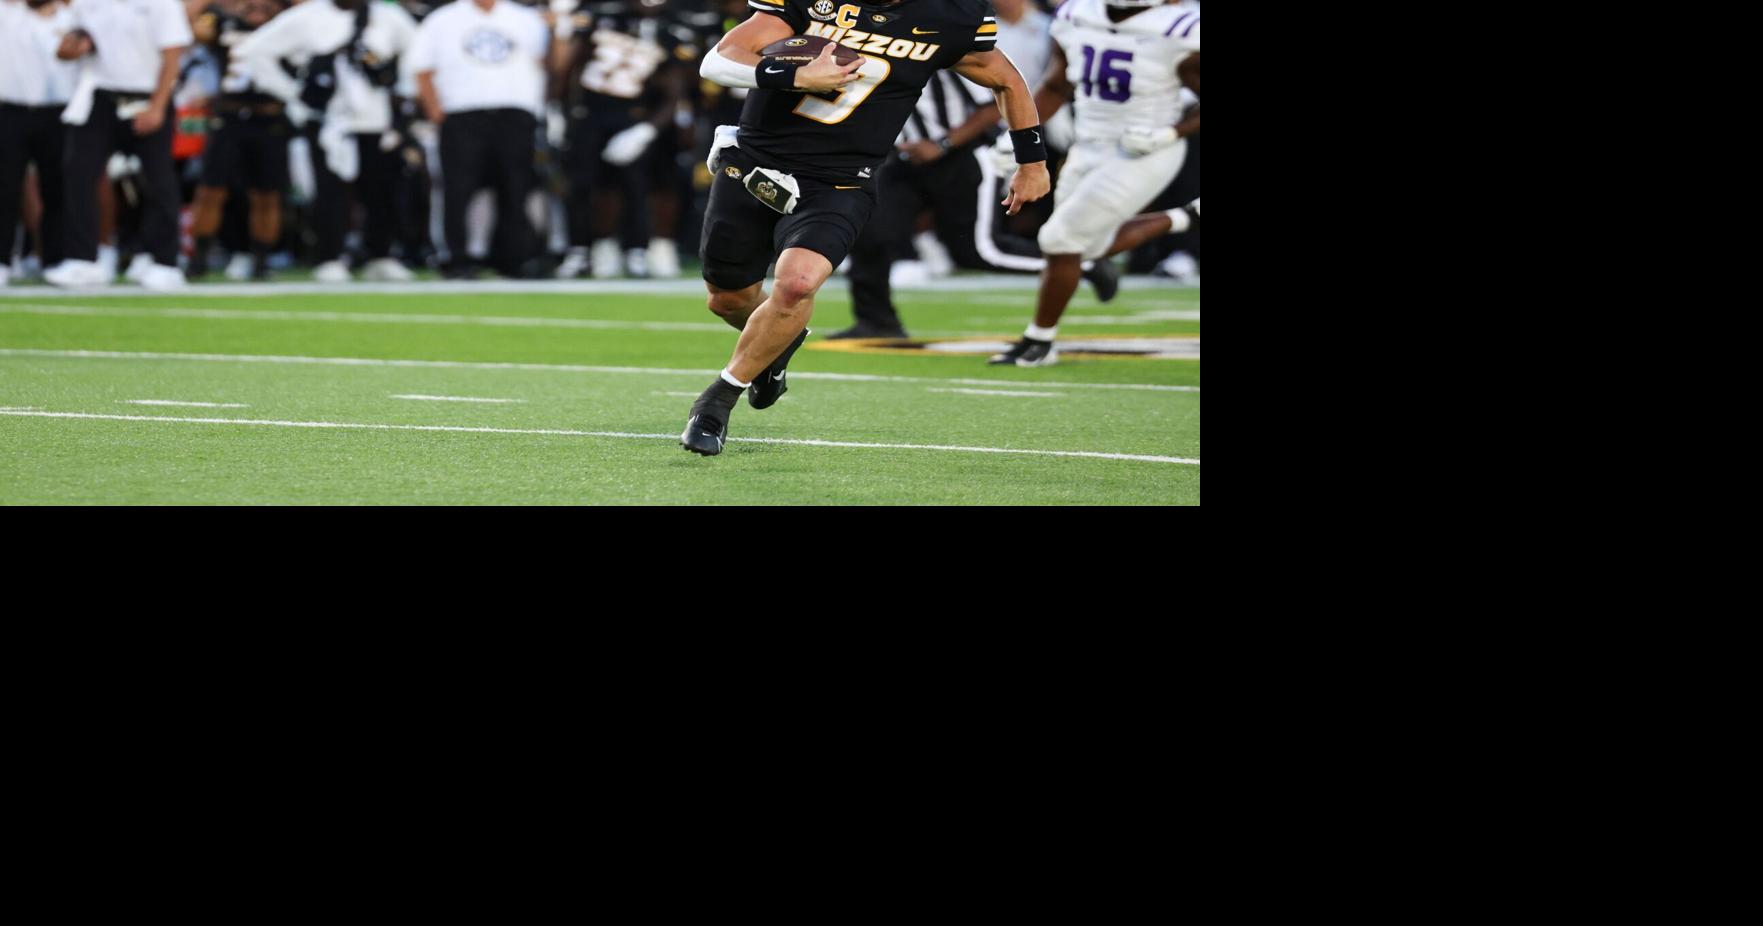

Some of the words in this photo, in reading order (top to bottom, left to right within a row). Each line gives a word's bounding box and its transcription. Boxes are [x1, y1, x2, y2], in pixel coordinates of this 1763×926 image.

[815, 0, 833, 14] SEC
[835, 4, 861, 29] C
[804, 20, 941, 62] MIZZOU
[1082, 45, 1134, 104] 16
